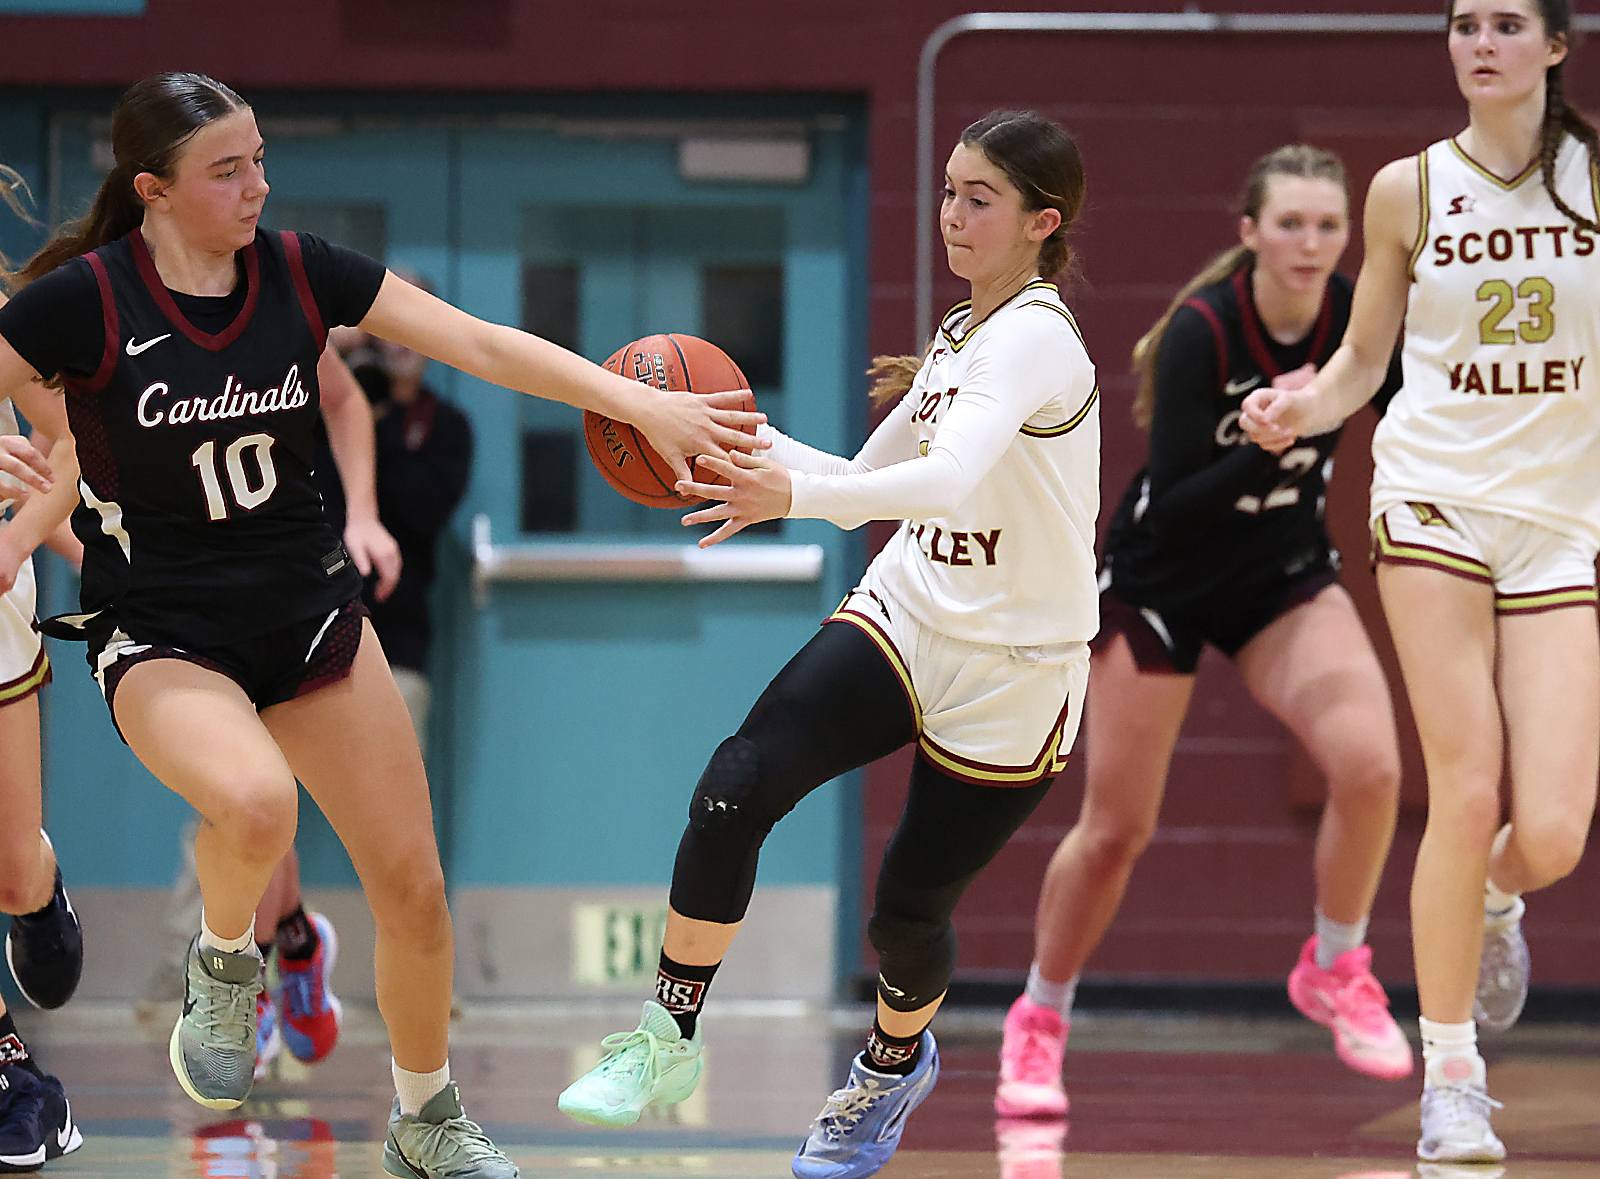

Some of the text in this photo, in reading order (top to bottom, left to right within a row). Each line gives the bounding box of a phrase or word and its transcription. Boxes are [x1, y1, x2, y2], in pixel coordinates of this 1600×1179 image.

[1433, 226, 1595, 266] SCOTTS
[1475, 276, 1555, 346] 23
[137, 362, 310, 428] Cardinals
[190, 430, 280, 523] 10
